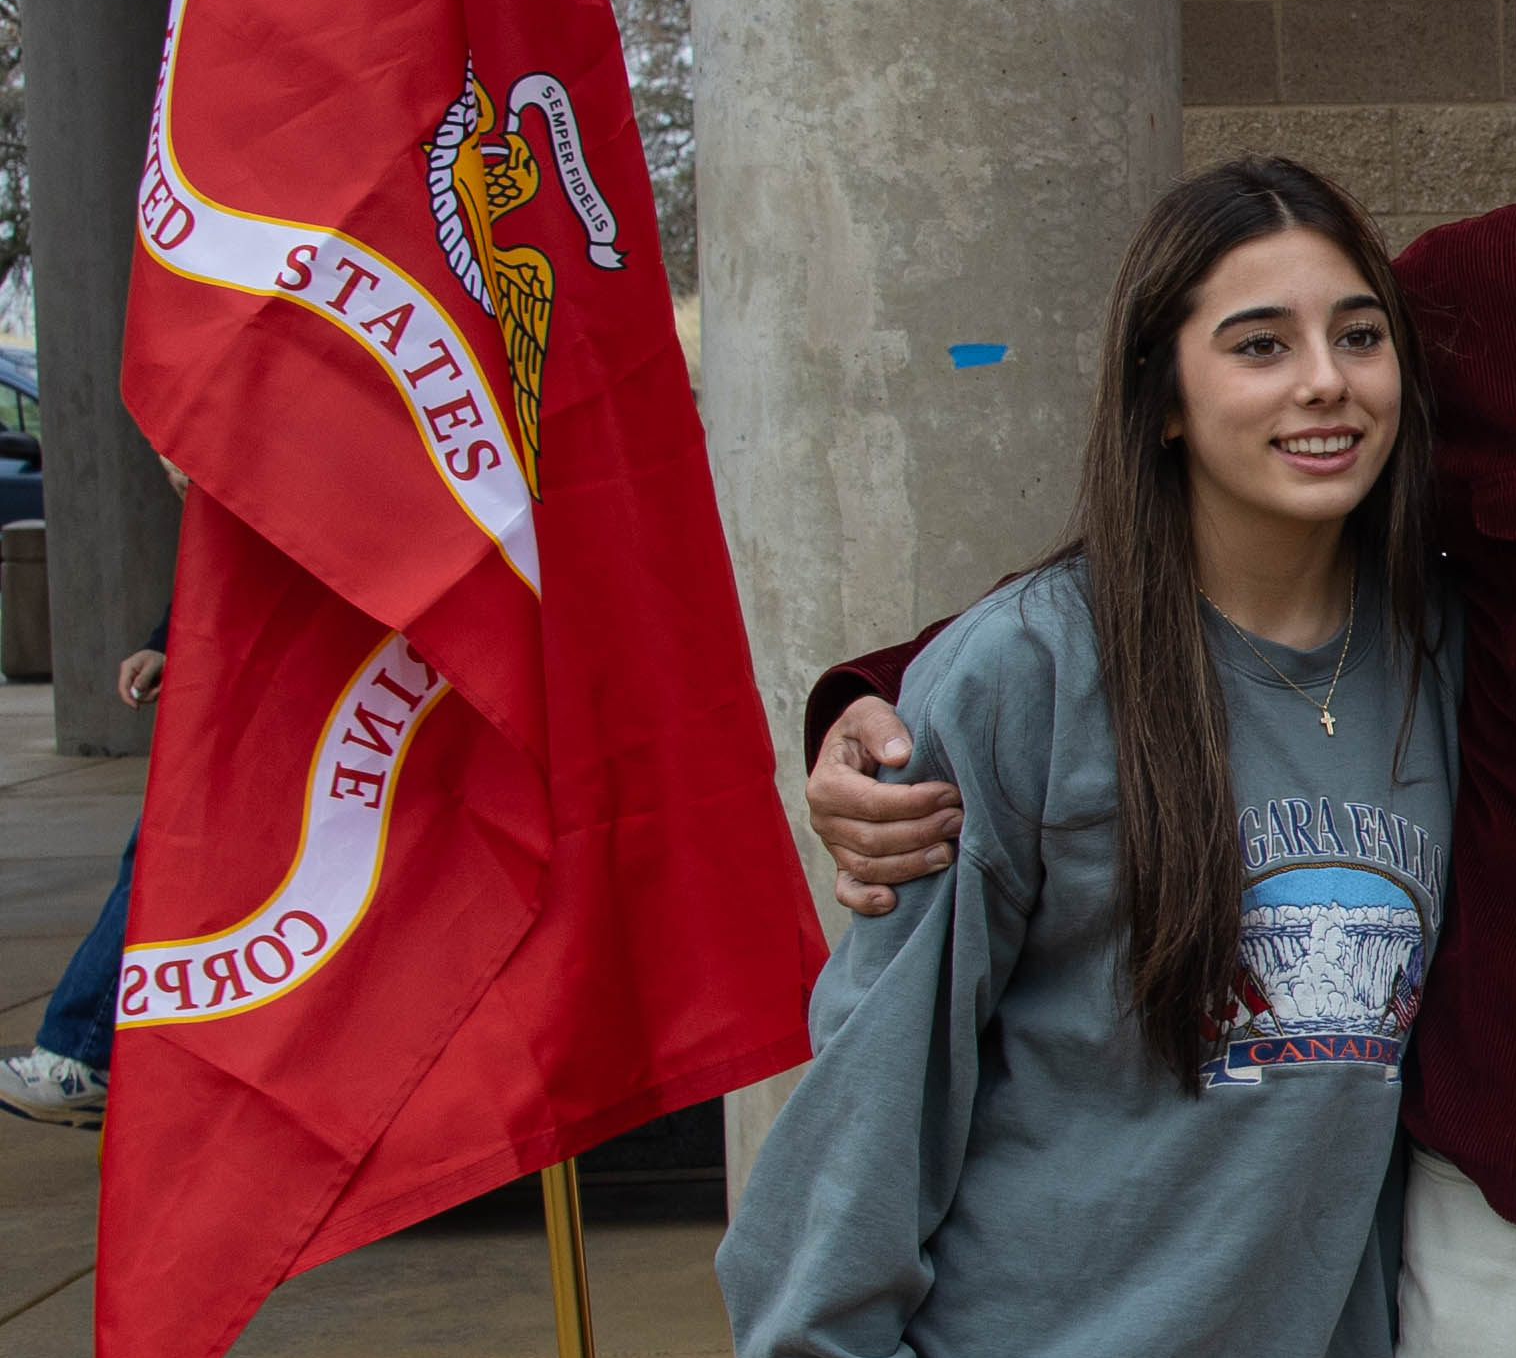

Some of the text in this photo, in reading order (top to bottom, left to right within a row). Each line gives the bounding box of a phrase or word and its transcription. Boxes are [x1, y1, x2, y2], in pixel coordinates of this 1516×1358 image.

[541, 85, 609, 234] SEMPER FIDELIS
[274, 243, 502, 482] STATES
[1238, 796, 1349, 872] GARA
